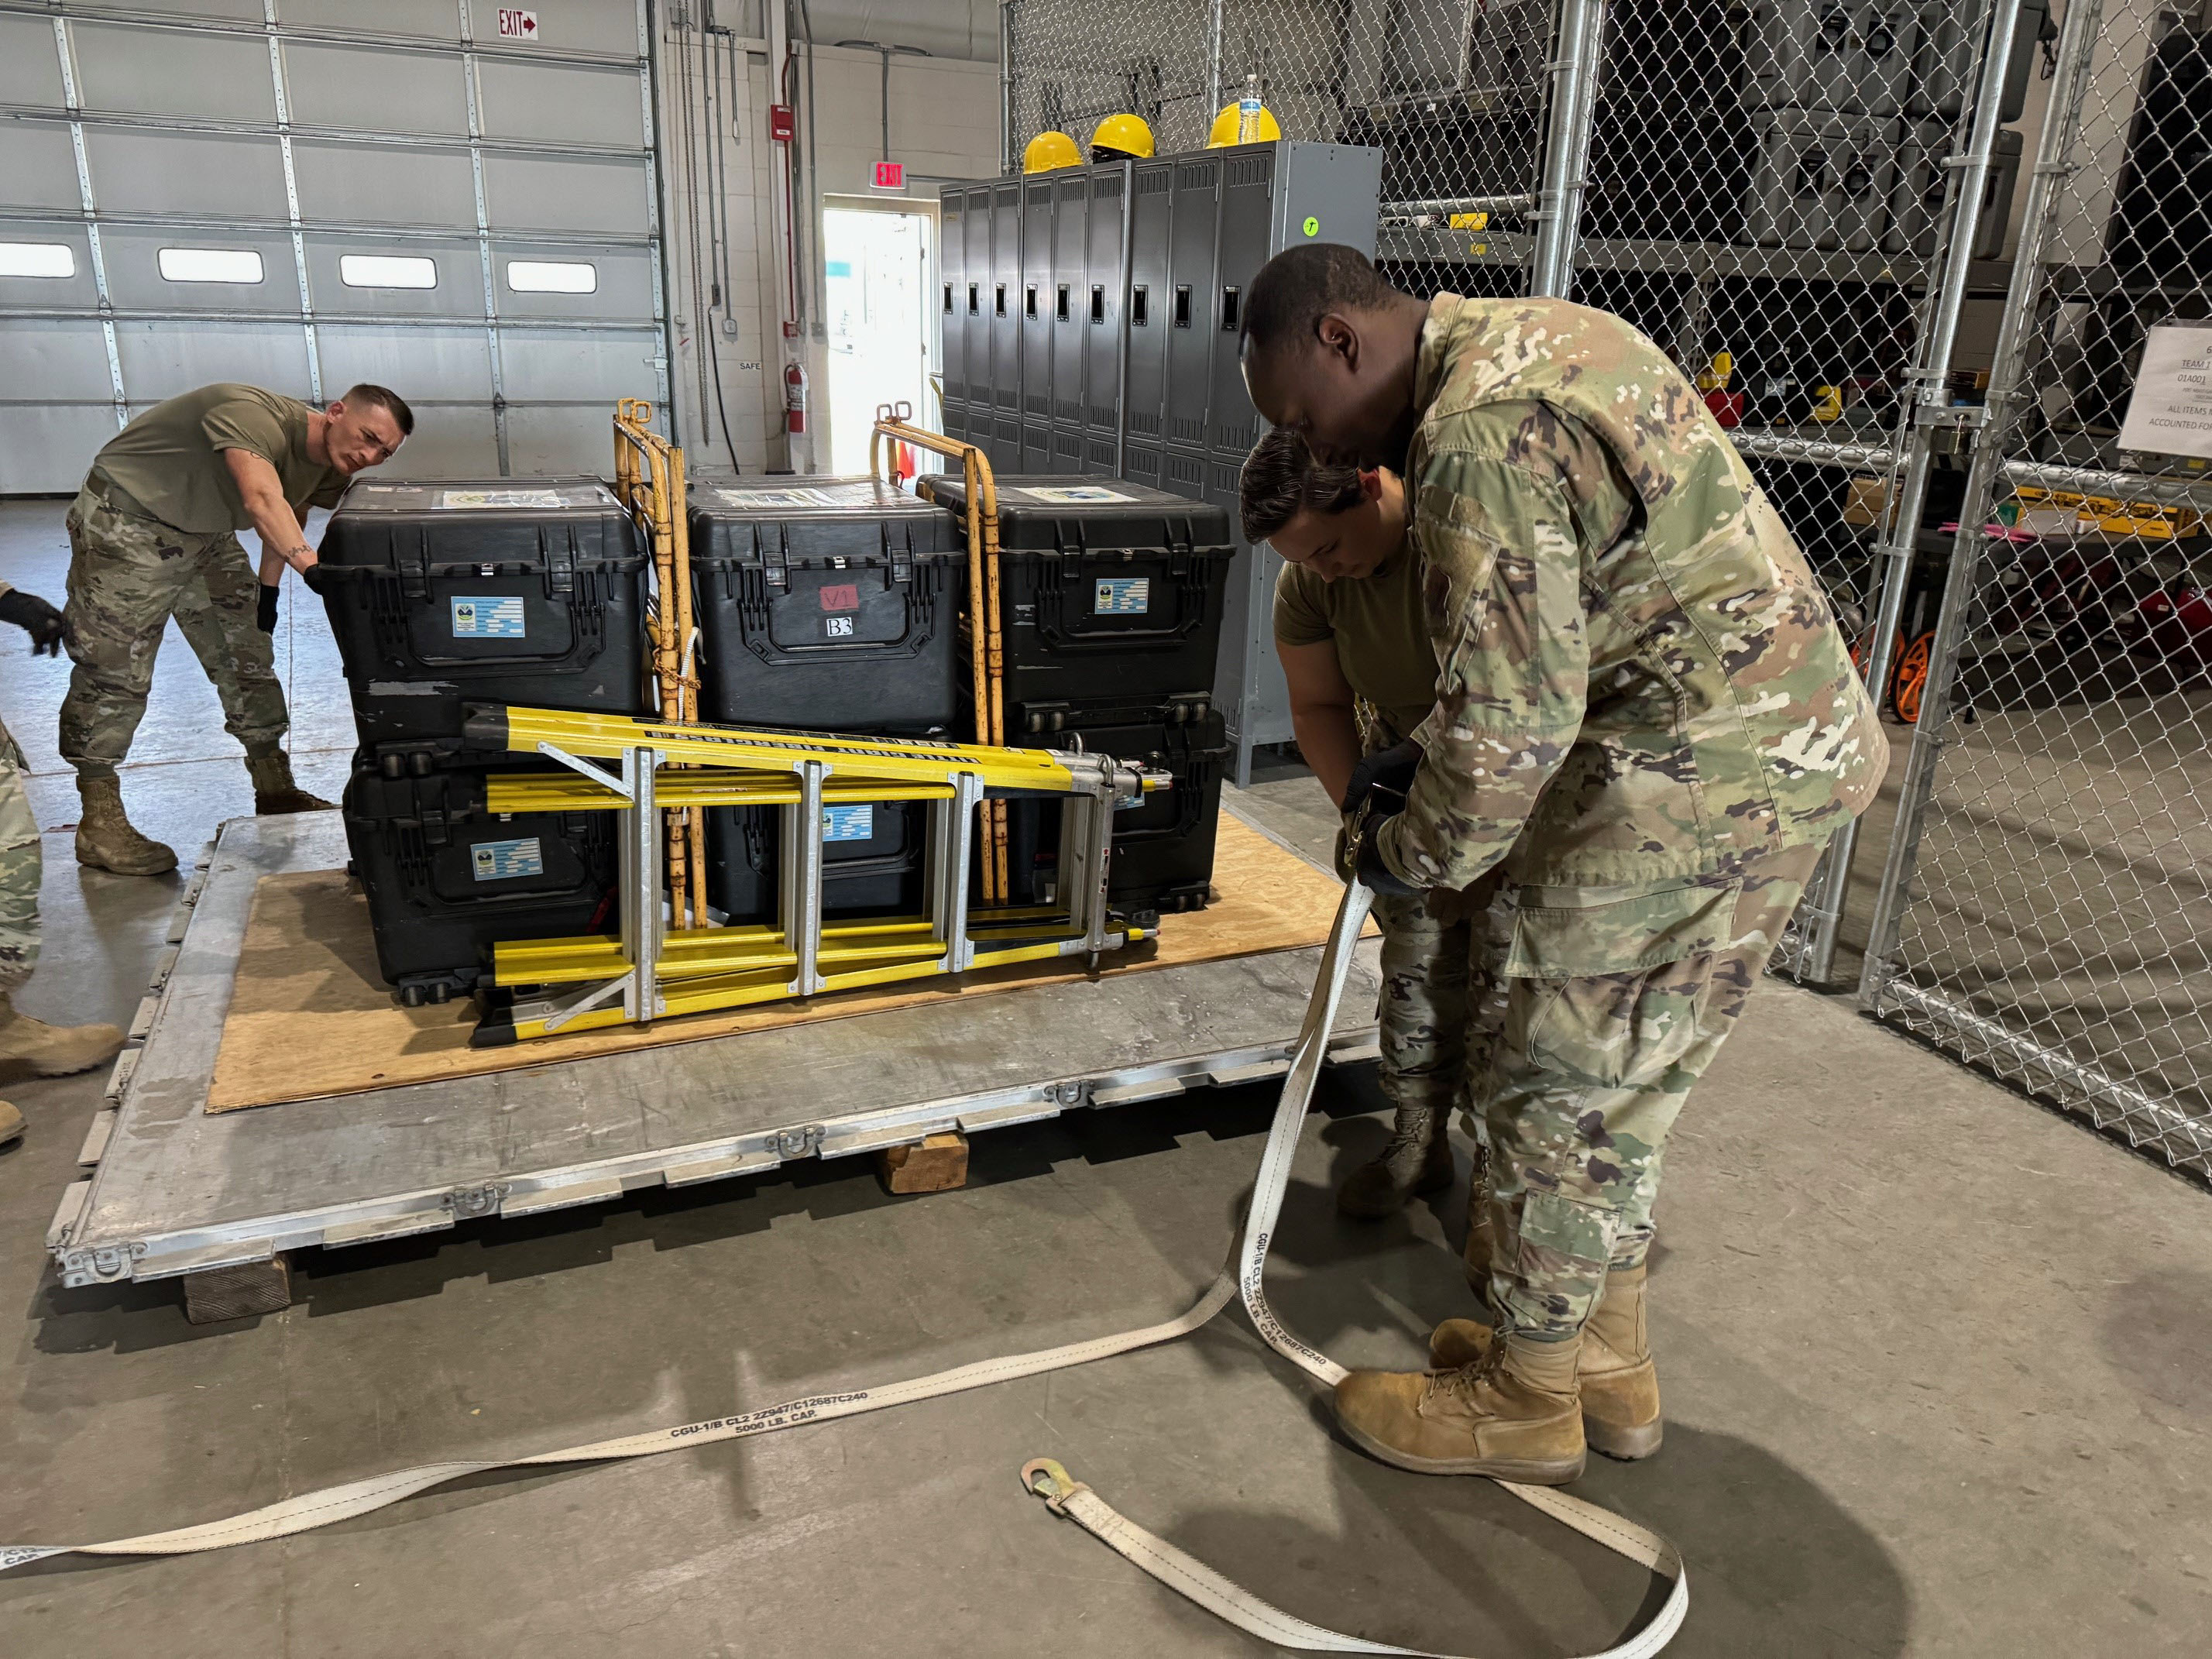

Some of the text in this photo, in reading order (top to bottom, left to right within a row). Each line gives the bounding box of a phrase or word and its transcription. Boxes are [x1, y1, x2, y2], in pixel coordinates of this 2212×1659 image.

[499, 9, 523, 36] EXIT
[2182, 359, 2205, 368] TEAM
[2167, 405, 2180, 414] ALL
[2183, 406, 2207, 415] ITEMS
[2148, 418, 2197, 429] ACCOUNTED
[828, 617, 851, 635] B3
[836, 747, 907, 758] GIANT
[1254, 1233, 1268, 1266] CGU-1/B
[1252, 1266, 1261, 1286] CL2
[1244, 1276, 1253, 1302] 5000
[671, 1420, 723, 1437] CGU-1/B
[726, 1415, 750, 1427] CL2
[735, 1410, 817, 1434] 5000 LB. CAP.
